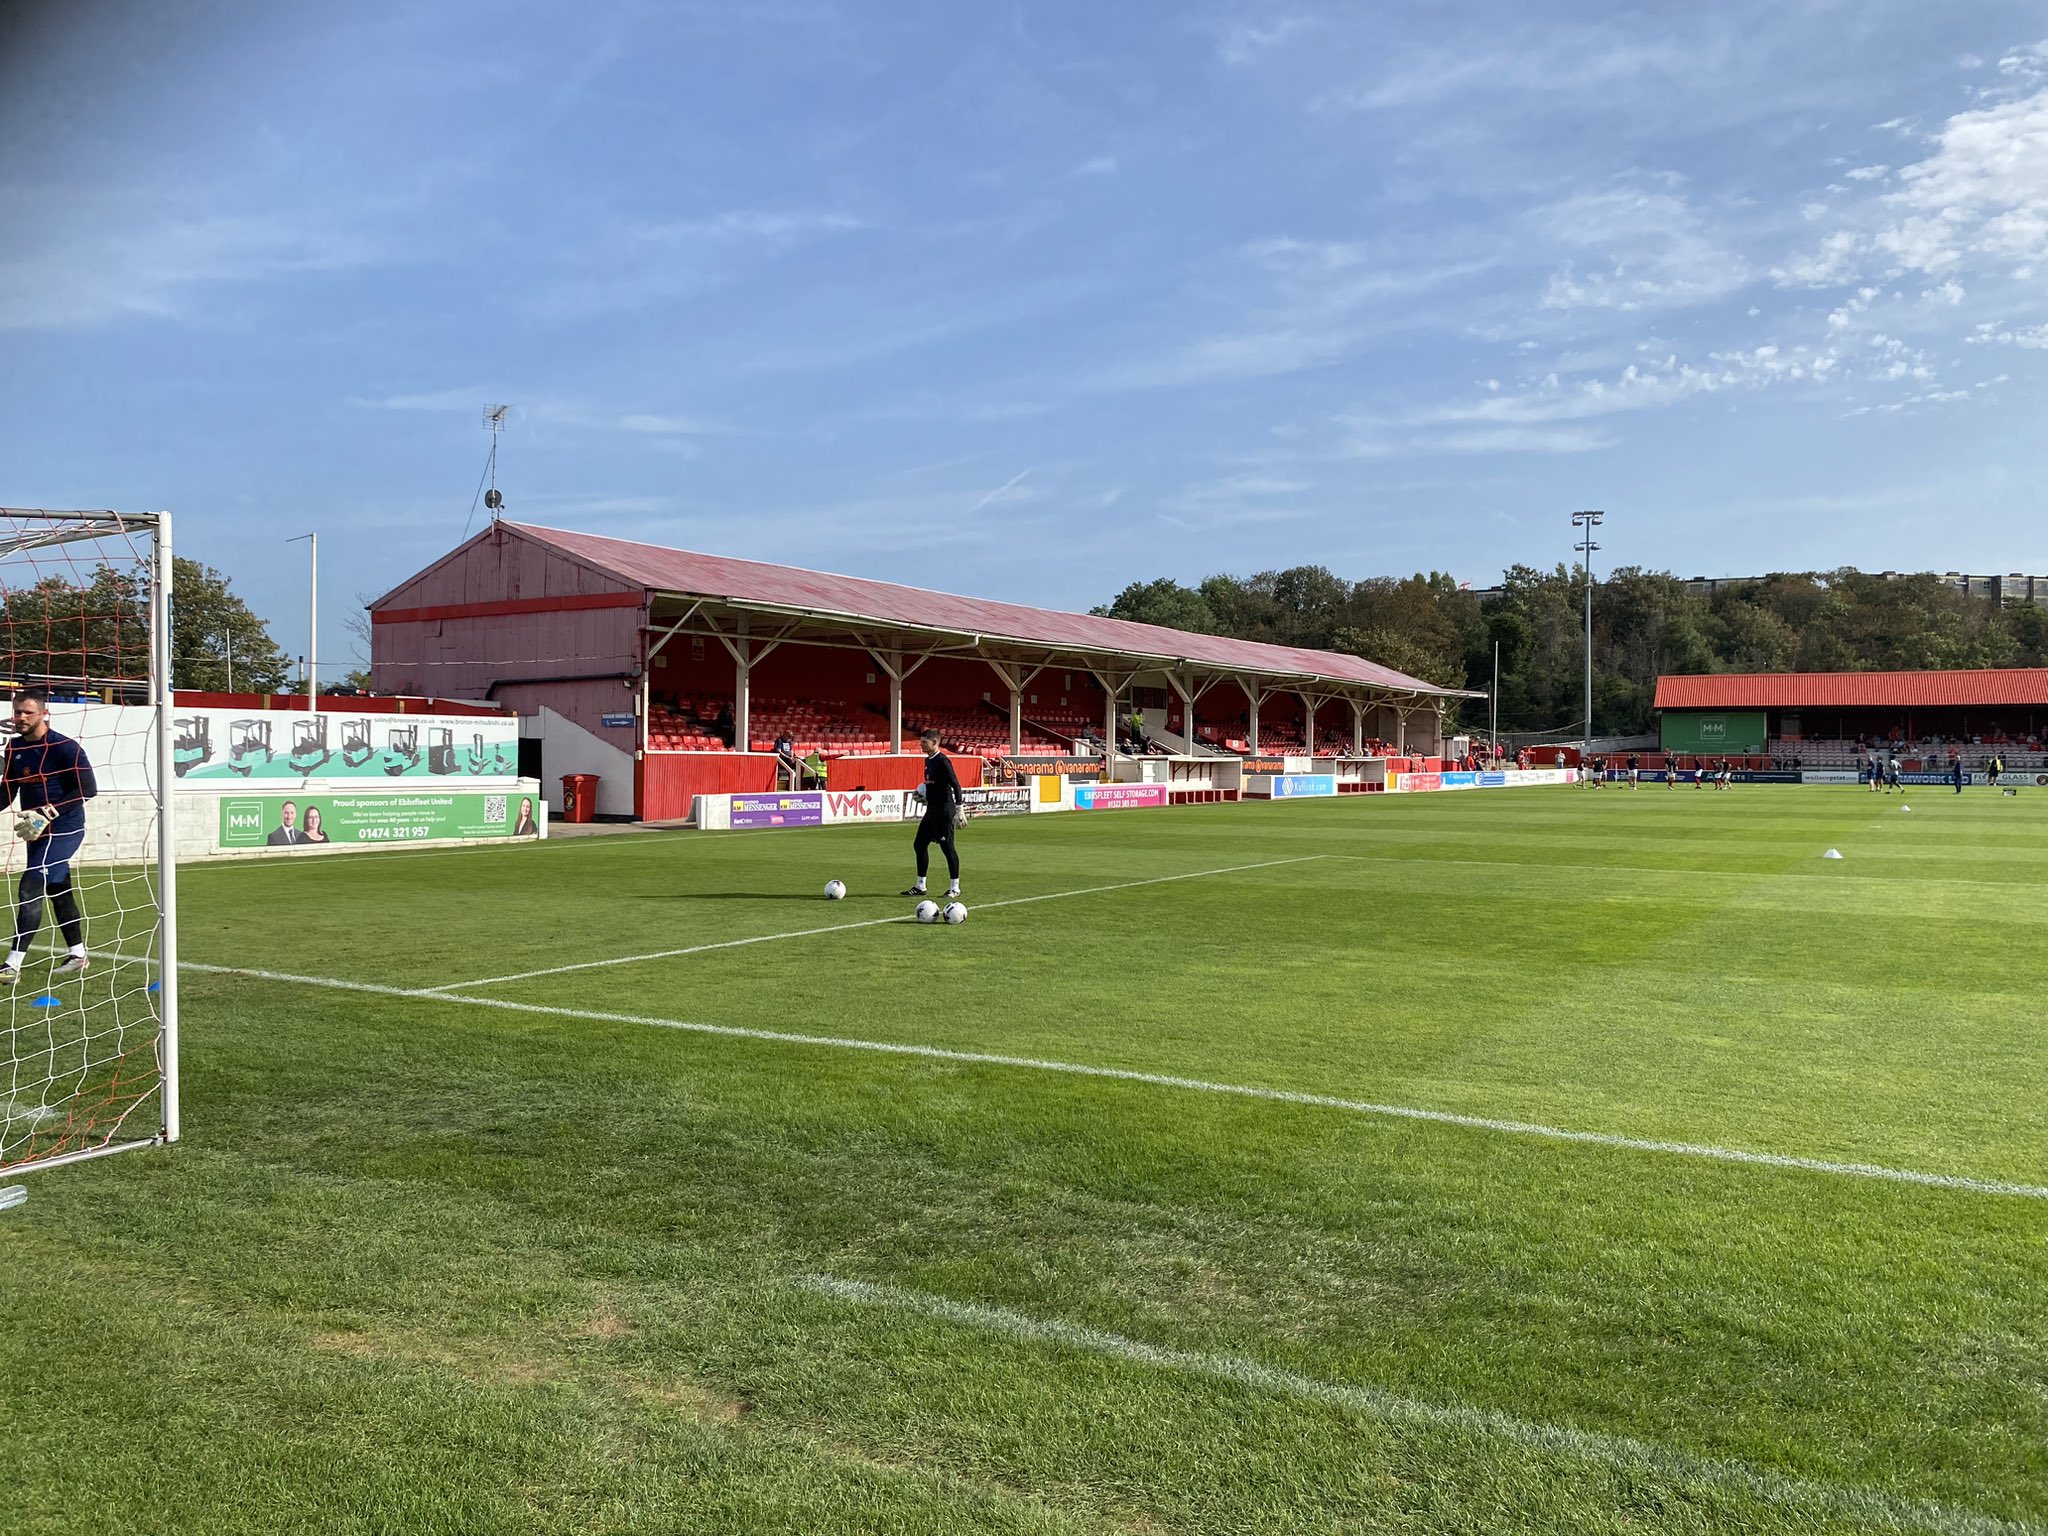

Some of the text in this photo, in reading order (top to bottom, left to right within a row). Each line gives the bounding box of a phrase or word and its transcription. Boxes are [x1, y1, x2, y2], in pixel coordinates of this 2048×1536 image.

[1948, 775, 1970, 785] LD
[988, 790, 1018, 801] Products
[1019, 789, 1029, 800] Ltd
[1084, 789, 1159, 800] EBBSFLEET SELF STORAGE.COM
[333, 799, 355, 807] Proud
[356, 799, 388, 808] sponsors
[399, 797, 430, 806] Ebbsfleet
[430, 797, 453, 806] United
[827, 794, 872, 816] VMC
[230, 814, 259, 828] M&M
[358, 826, 430, 839] 01474 321 957
